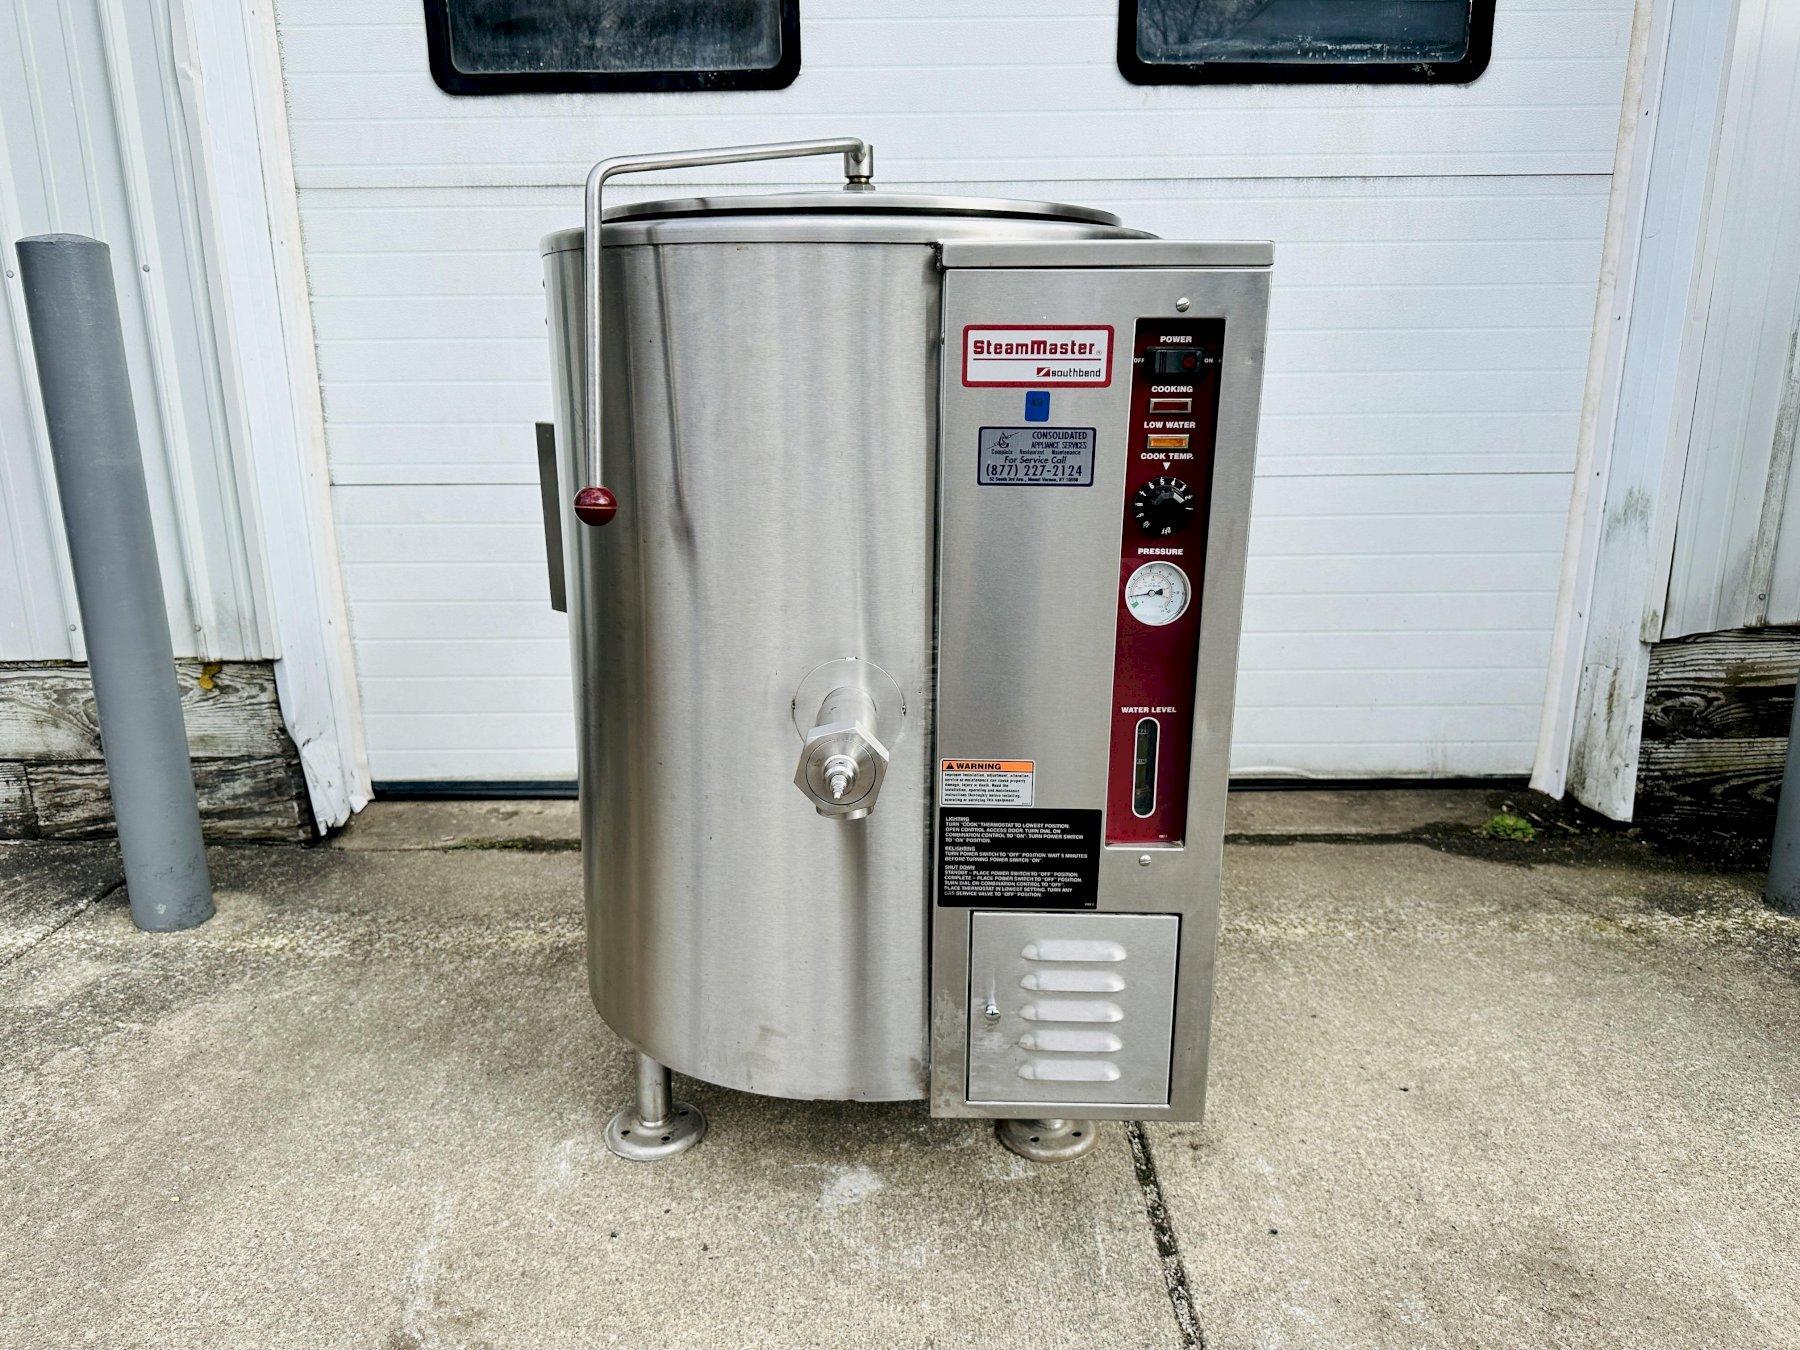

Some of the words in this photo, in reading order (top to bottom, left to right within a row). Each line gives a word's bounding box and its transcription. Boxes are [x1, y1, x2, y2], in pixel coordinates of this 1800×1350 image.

[1051, 368, 1100, 377] southbend
[1032, 431, 1088, 440] CONSOLIDATED
[986, 464, 1018, 476] (877)
[1024, 465, 1082, 476] 227-2124
[1160, 477, 1164, 485] 5
